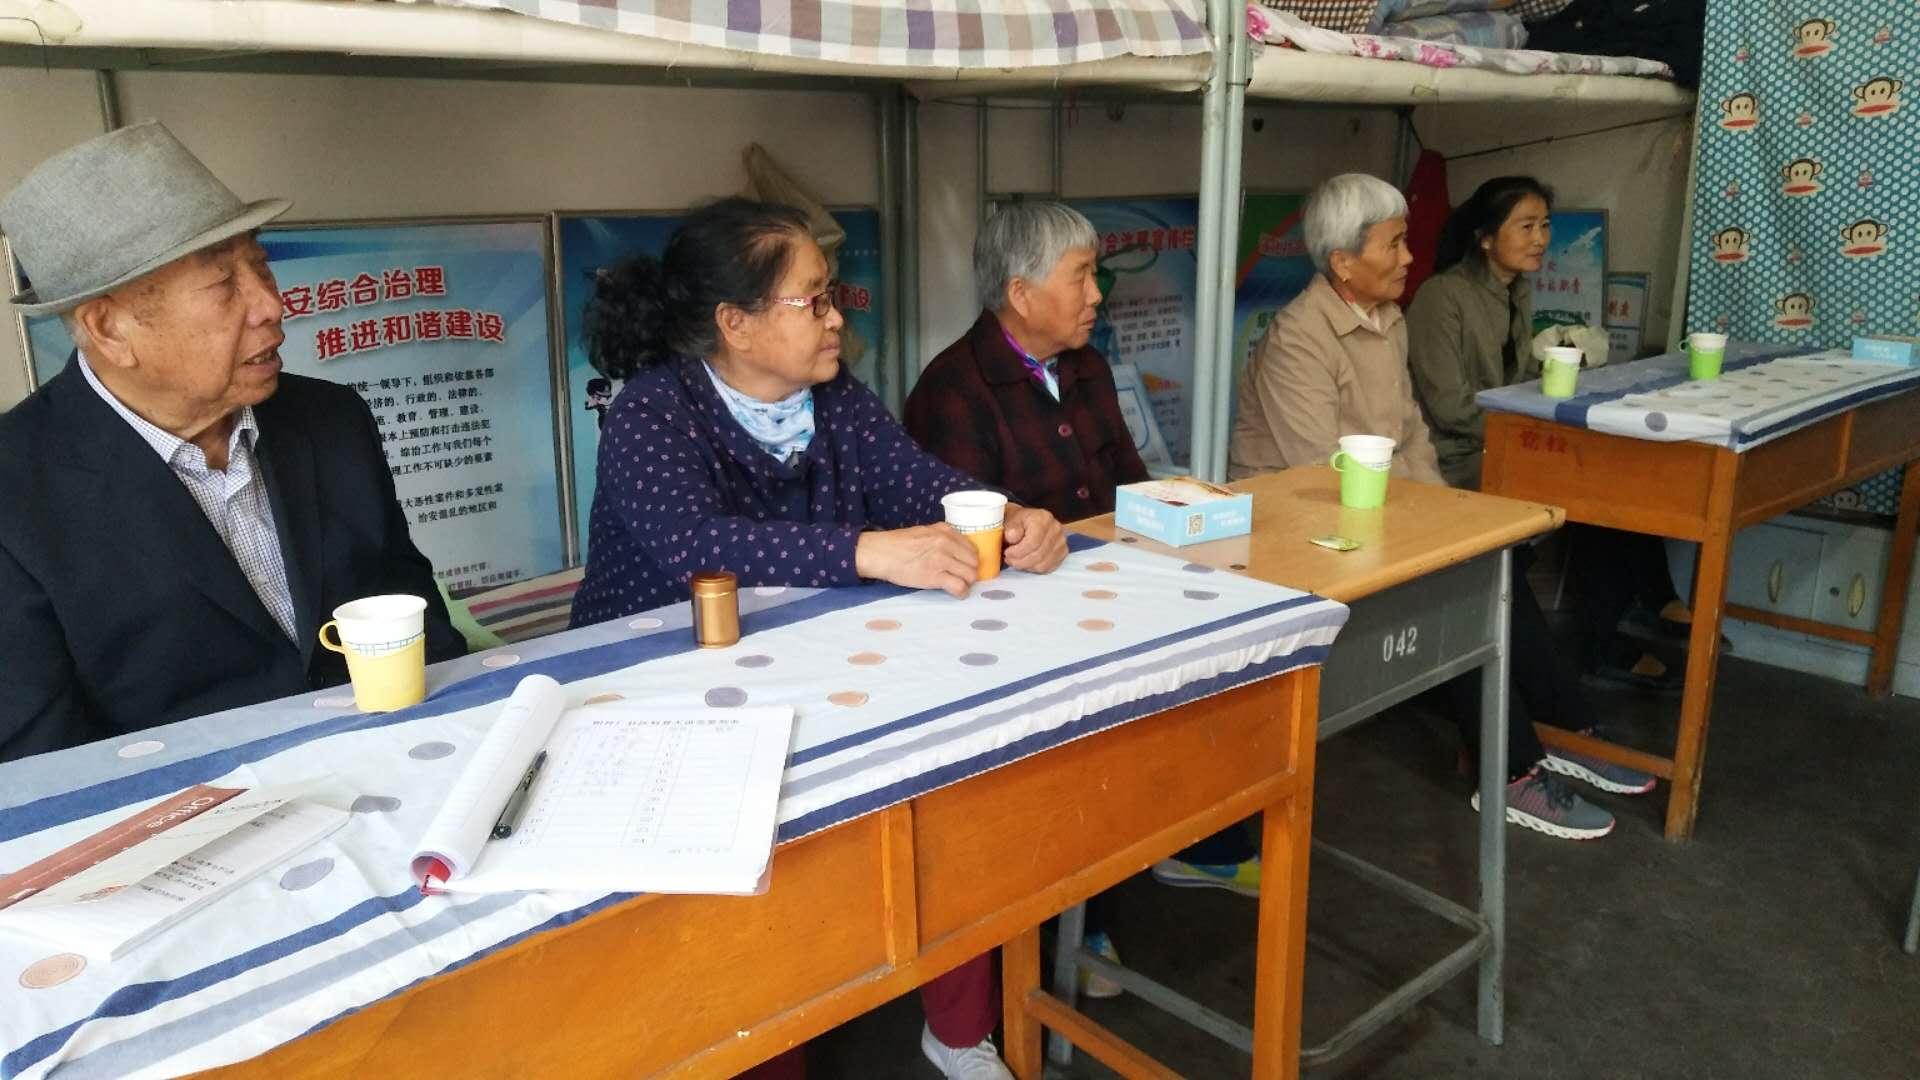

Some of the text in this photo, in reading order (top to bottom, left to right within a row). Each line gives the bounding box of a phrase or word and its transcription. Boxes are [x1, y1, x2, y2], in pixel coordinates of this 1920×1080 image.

[282, 266, 446, 319] 安综合治理
[316, 310, 504, 360] 推进和谐建设
[1383, 627, 1418, 663] 042
